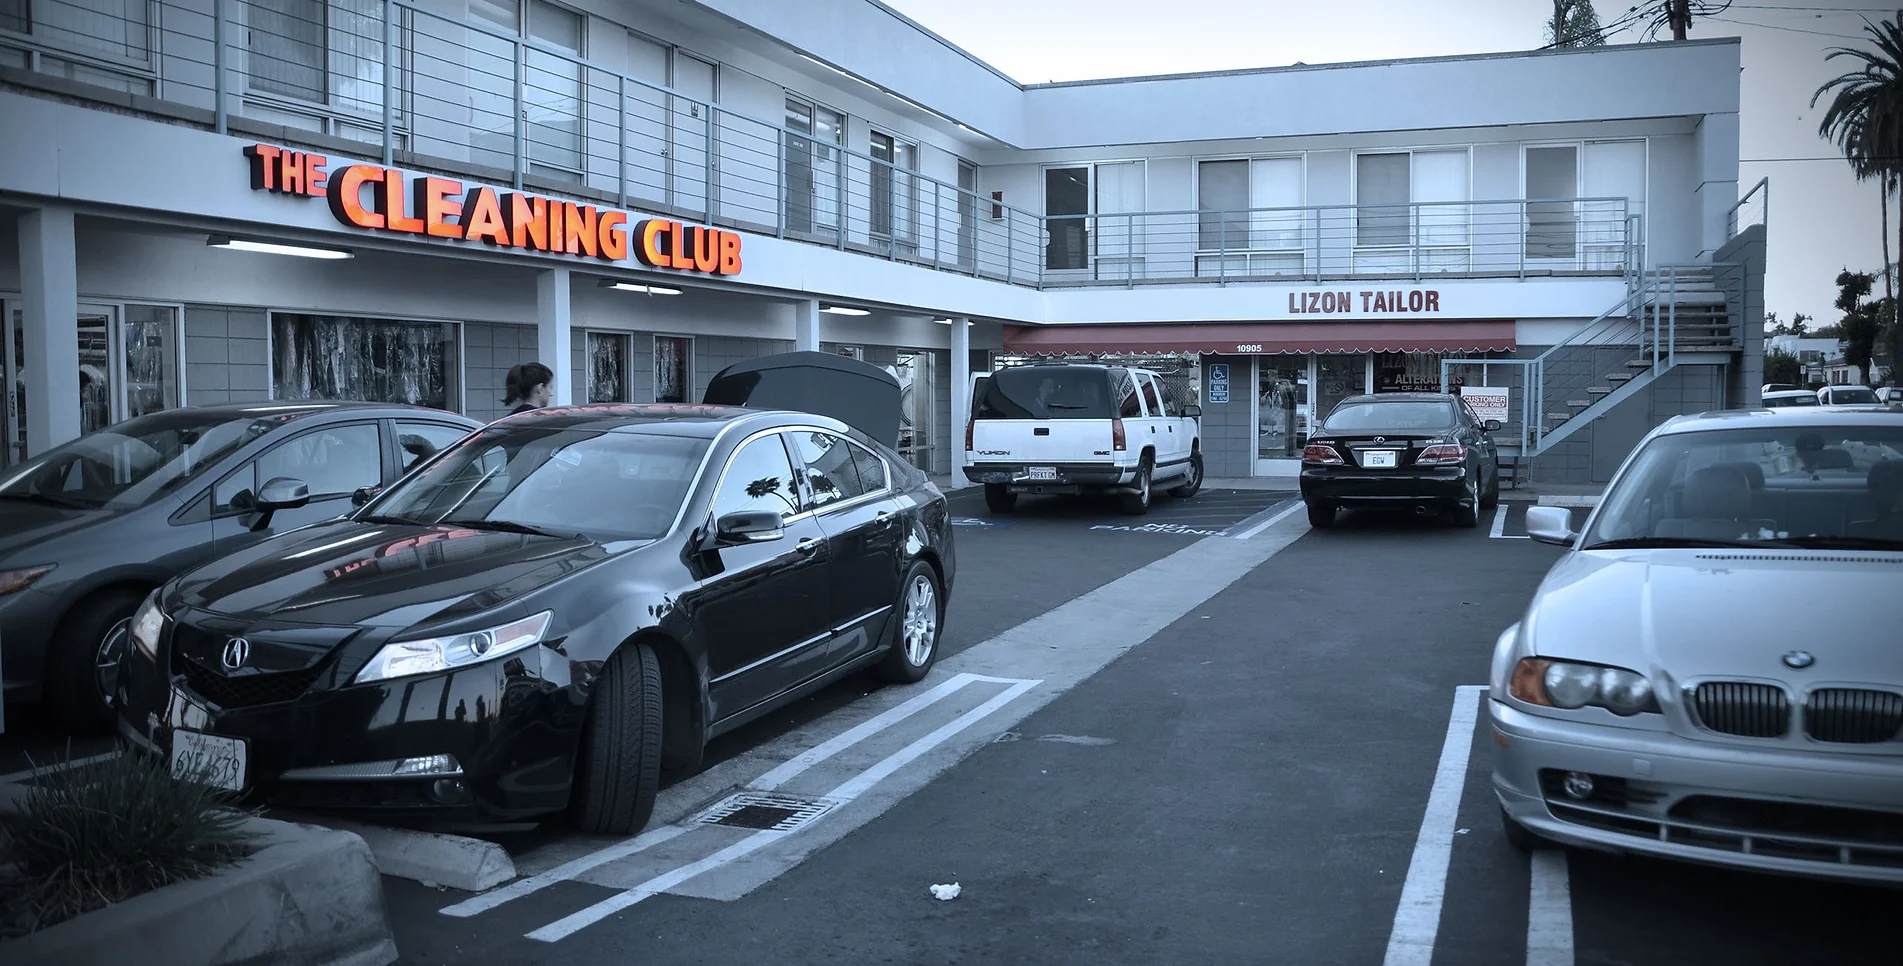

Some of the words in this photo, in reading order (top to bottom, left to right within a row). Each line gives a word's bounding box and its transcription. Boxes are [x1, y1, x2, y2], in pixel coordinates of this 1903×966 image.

[245, 143, 327, 198] THE
[329, 163, 627, 261] CLEANING
[633, 217, 743, 275] CLUB
[1288, 291, 1351, 314] LIZON
[1360, 290, 1440, 313] TAILOR
[1236, 344, 1262, 352] 10905
[1395, 374, 1463, 384] ALTERATINS
[1463, 395, 1506, 403] CUSTOMER
[1372, 456, 1385, 465] EGW
[1089, 525, 1228, 536] PARKING
